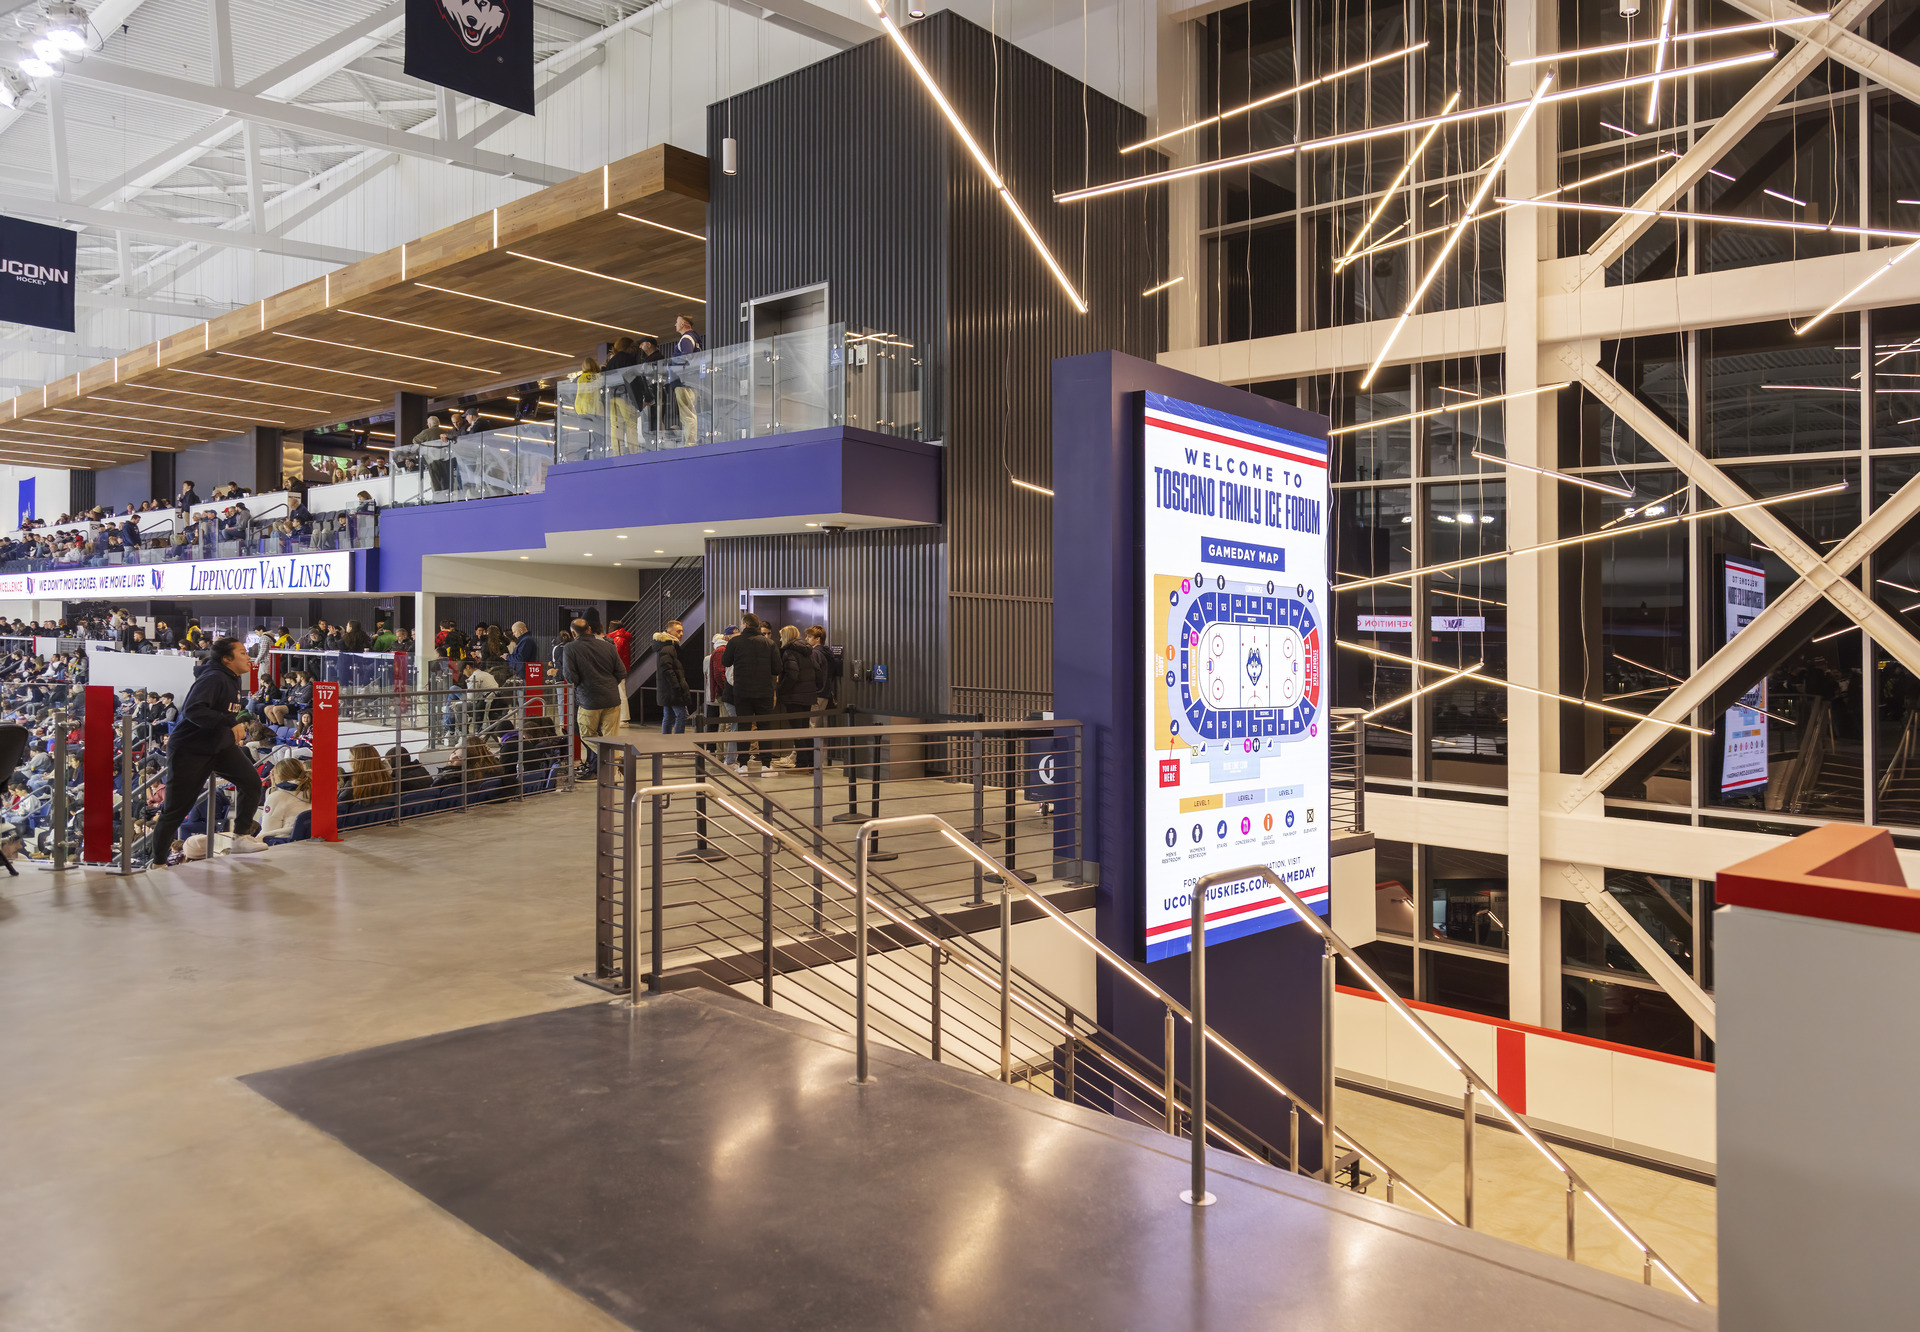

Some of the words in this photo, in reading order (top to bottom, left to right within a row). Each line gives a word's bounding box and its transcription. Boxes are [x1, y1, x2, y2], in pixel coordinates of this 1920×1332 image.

[16, 276, 47, 286] HOCKEY
[1184, 447, 1273, 482] WELCOME
[1283, 470, 1302, 488] TO
[1154, 466, 1215, 517] TOSCANO
[1219, 480, 1262, 525] FAMILY
[1265, 489, 1282, 529] ICE
[1285, 494, 1320, 535] FORUM
[1208, 543, 1256, 562] GAMEDAY
[1258, 551, 1279, 564] MAP
[39, 579, 47, 591] WE
[63, 578, 78, 590] MOVE
[99, 576, 109, 588] WE
[109, 575, 127, 588] MOVE
[127, 574, 145, 588] LIVES
[189, 565, 258, 591] LIPPINCOTT
[259, 560, 286, 589] VAN
[288, 558, 331, 588] LINES
[0, 581, 23, 592] CELLENCE
[317, 691, 334, 700] 117
[1163, 772, 1176, 782] HERE
[1278, 789, 1290, 797] LEVEL
[1183, 877, 1197, 888] FOR
[1287, 856, 1301, 866] VISIT
